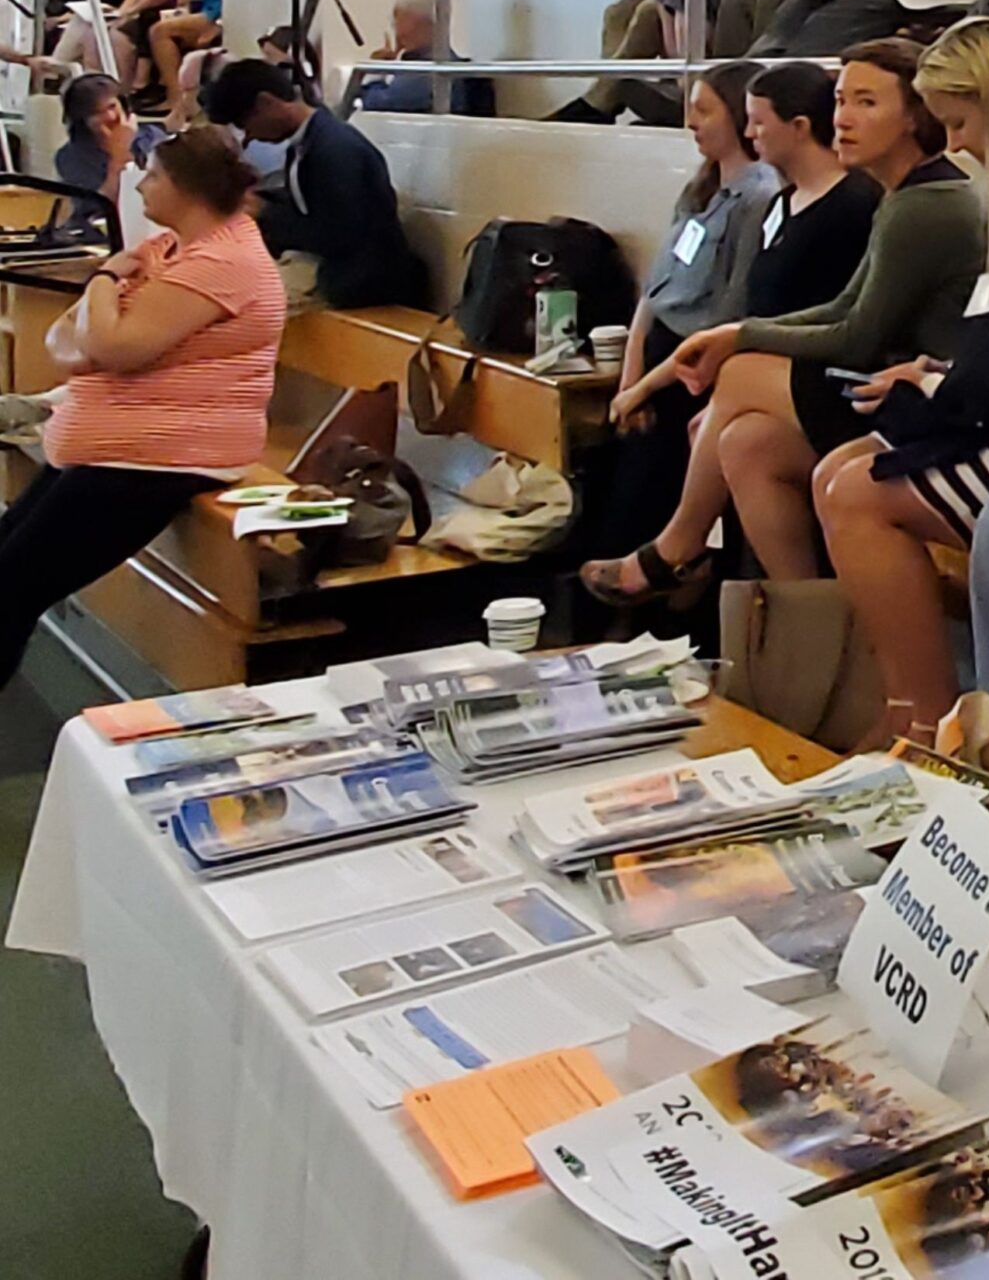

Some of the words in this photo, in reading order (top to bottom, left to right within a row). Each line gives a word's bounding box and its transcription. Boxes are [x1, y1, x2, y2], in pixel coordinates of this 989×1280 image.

[920, 815, 989, 901] Become
[881, 868, 954, 959] Member
[950, 948, 979, 984] of
[873, 944, 928, 1024] VCRD
[633, 1111, 662, 1137] AN
[838, 1225, 894, 1280] 201
